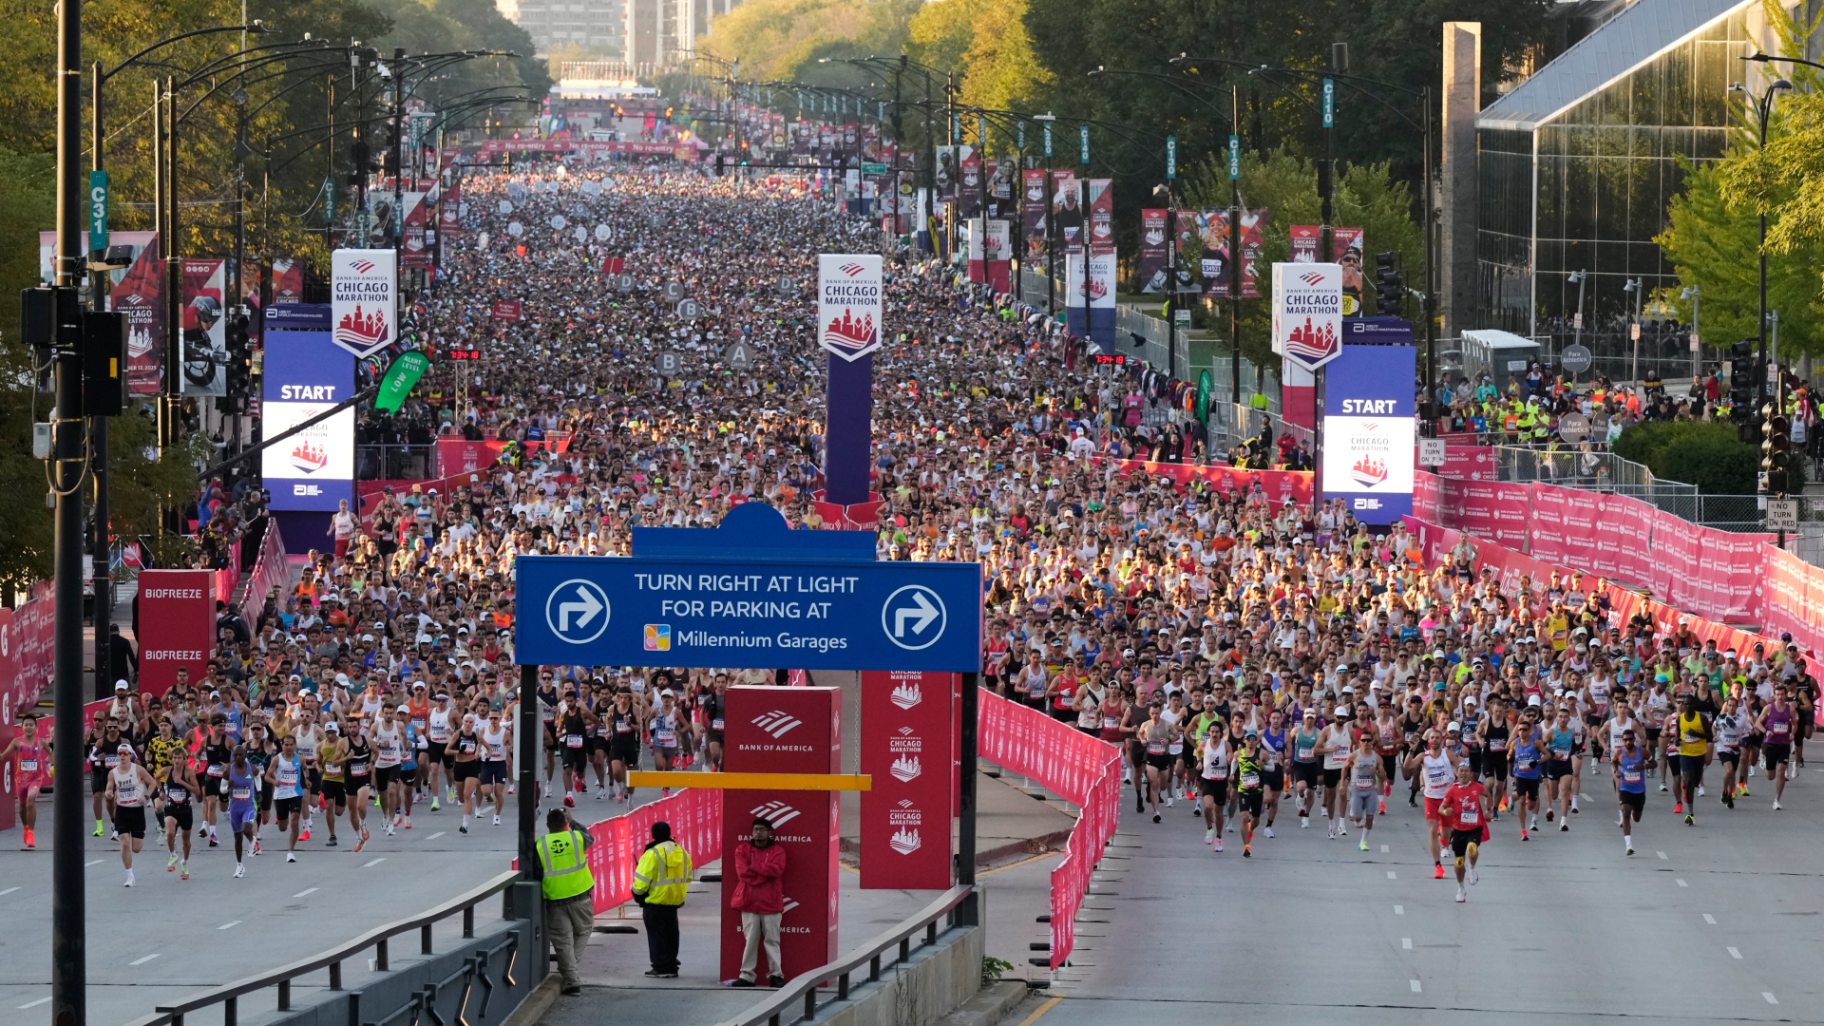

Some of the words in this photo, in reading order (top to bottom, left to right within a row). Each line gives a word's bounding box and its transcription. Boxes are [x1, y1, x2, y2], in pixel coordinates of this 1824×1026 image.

[1324, 84, 1333, 124] C110
[1167, 141, 1175, 174] C130
[1230, 140, 1238, 176] C120
[91, 186, 106, 234] C31
[357, 214, 365, 248] C131
[336, 282, 388, 293] CHICAGO
[622, 276, 632, 287] D
[668, 284, 677, 296] C
[825, 286, 878, 296] CHICAGO
[825, 297, 878, 305] MARATHON
[1286, 295, 1338, 305] CHICAGO
[687, 304, 696, 315] B
[404, 356, 422, 366] ALERT
[732, 346, 746, 362] A
[402, 362, 420, 372] LEVEL
[663, 355, 674, 369] B
[391, 372, 406, 393] LOW
[281, 385, 335, 400] START
[1342, 399, 1397, 414] START
[634, 574, 692, 590] TURN
[698, 575, 762, 592] RIGHT
[767, 576, 792, 592] AT
[798, 576, 858, 593] LIGHT
[662, 600, 704, 616] FOR
[711, 601, 801, 618] PARKING
[806, 603, 832, 618] AT
[678, 631, 772, 647] Millennium
[777, 632, 847, 653] Garages
